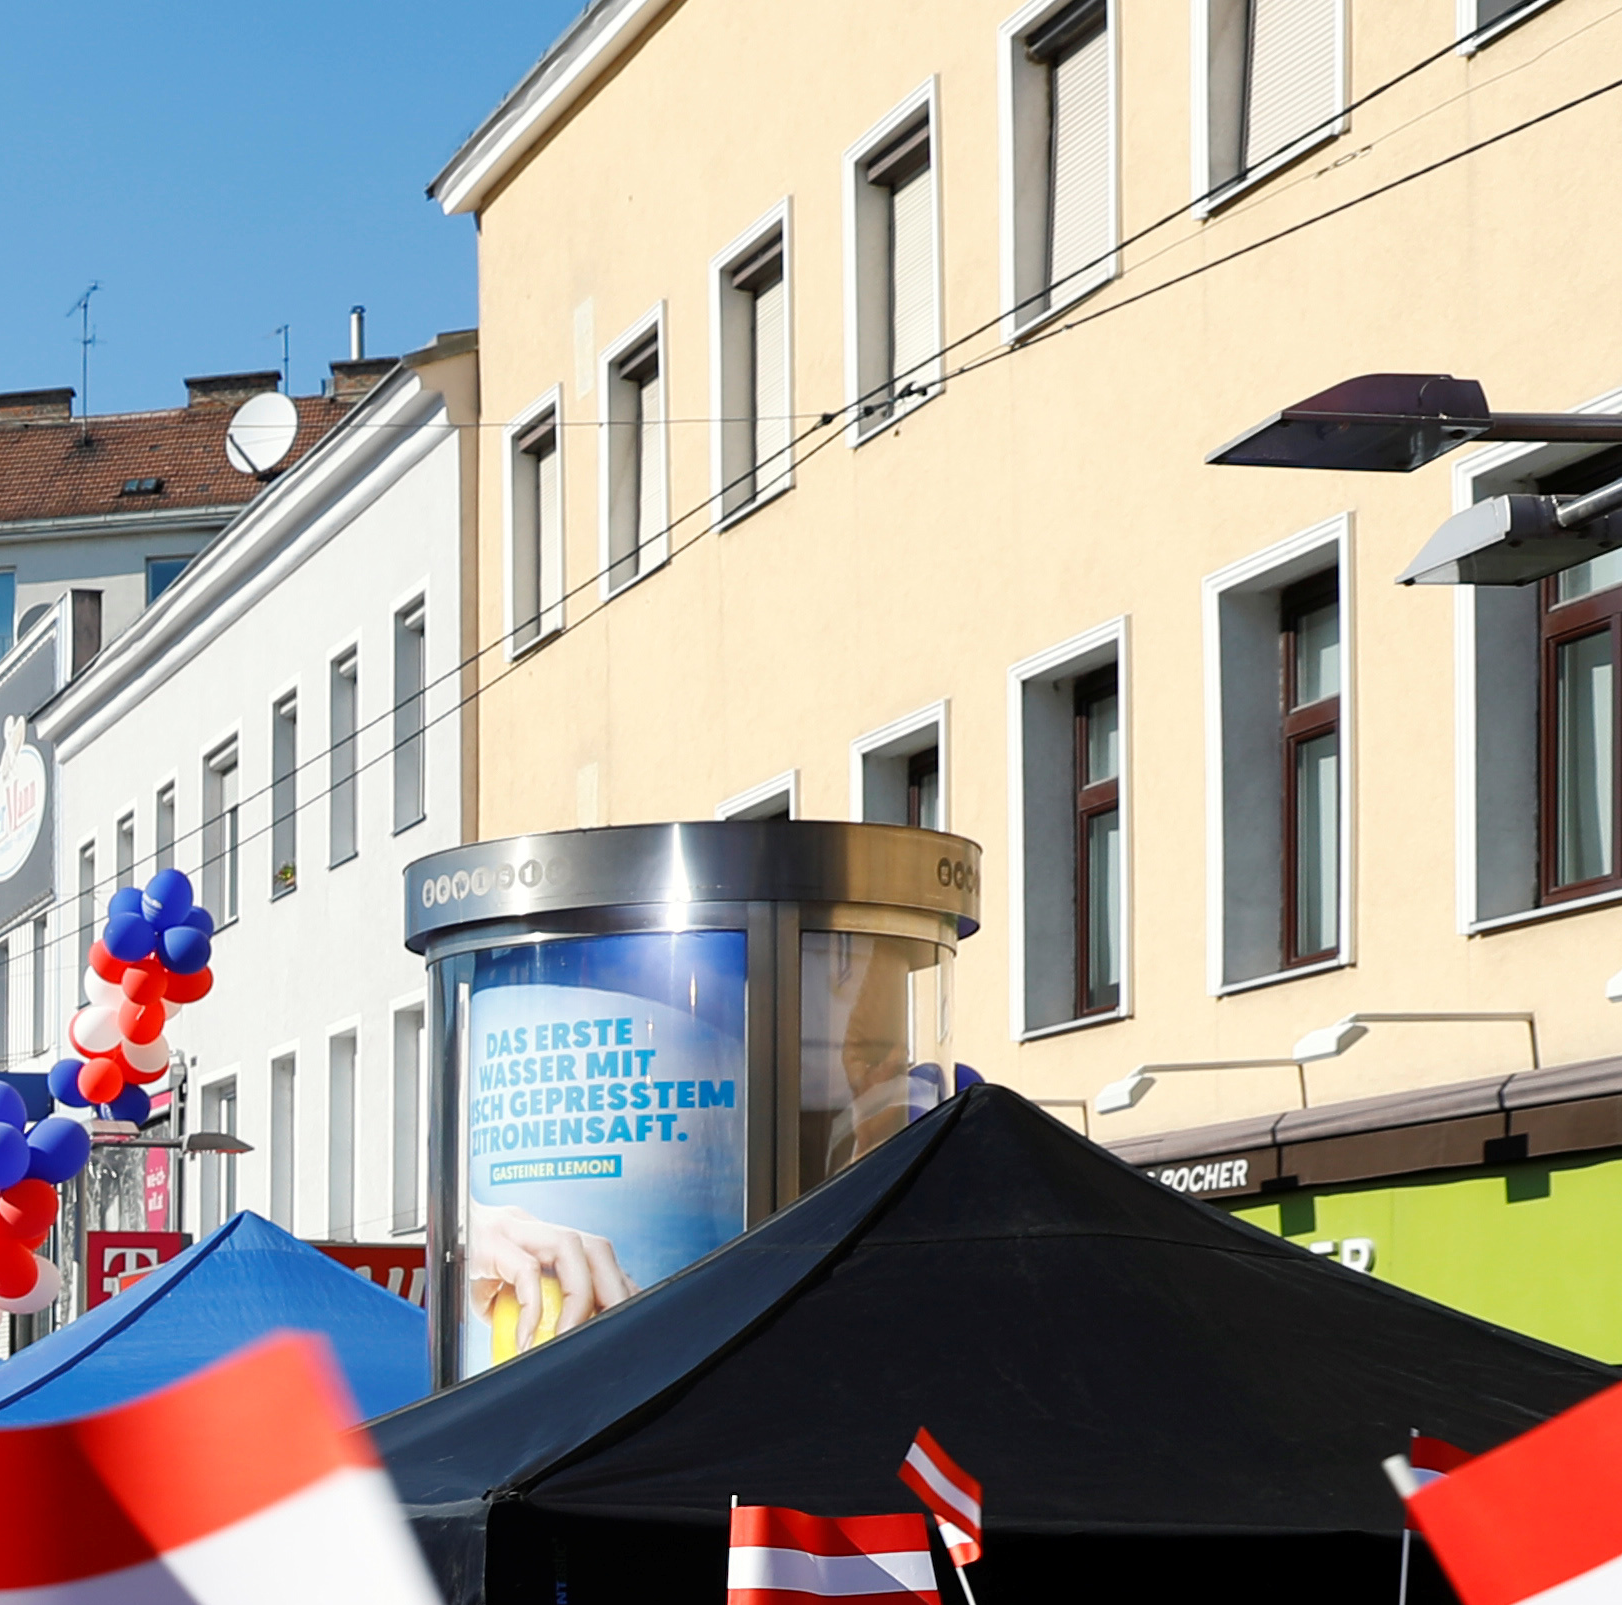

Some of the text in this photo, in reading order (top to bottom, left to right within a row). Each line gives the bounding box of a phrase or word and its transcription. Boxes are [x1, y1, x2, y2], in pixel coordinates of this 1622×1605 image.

[486, 1017, 633, 1060] DAS ERSTE
[479, 1049, 656, 1093] WASSER MIT
[509, 1079, 735, 1119] GEPRESSTEM
[472, 1113, 689, 1157] ZITRONENSAFT.
[492, 1159, 616, 1182] GASTEINER LEMON
[1160, 1158, 1249, 1193] ROCHER
